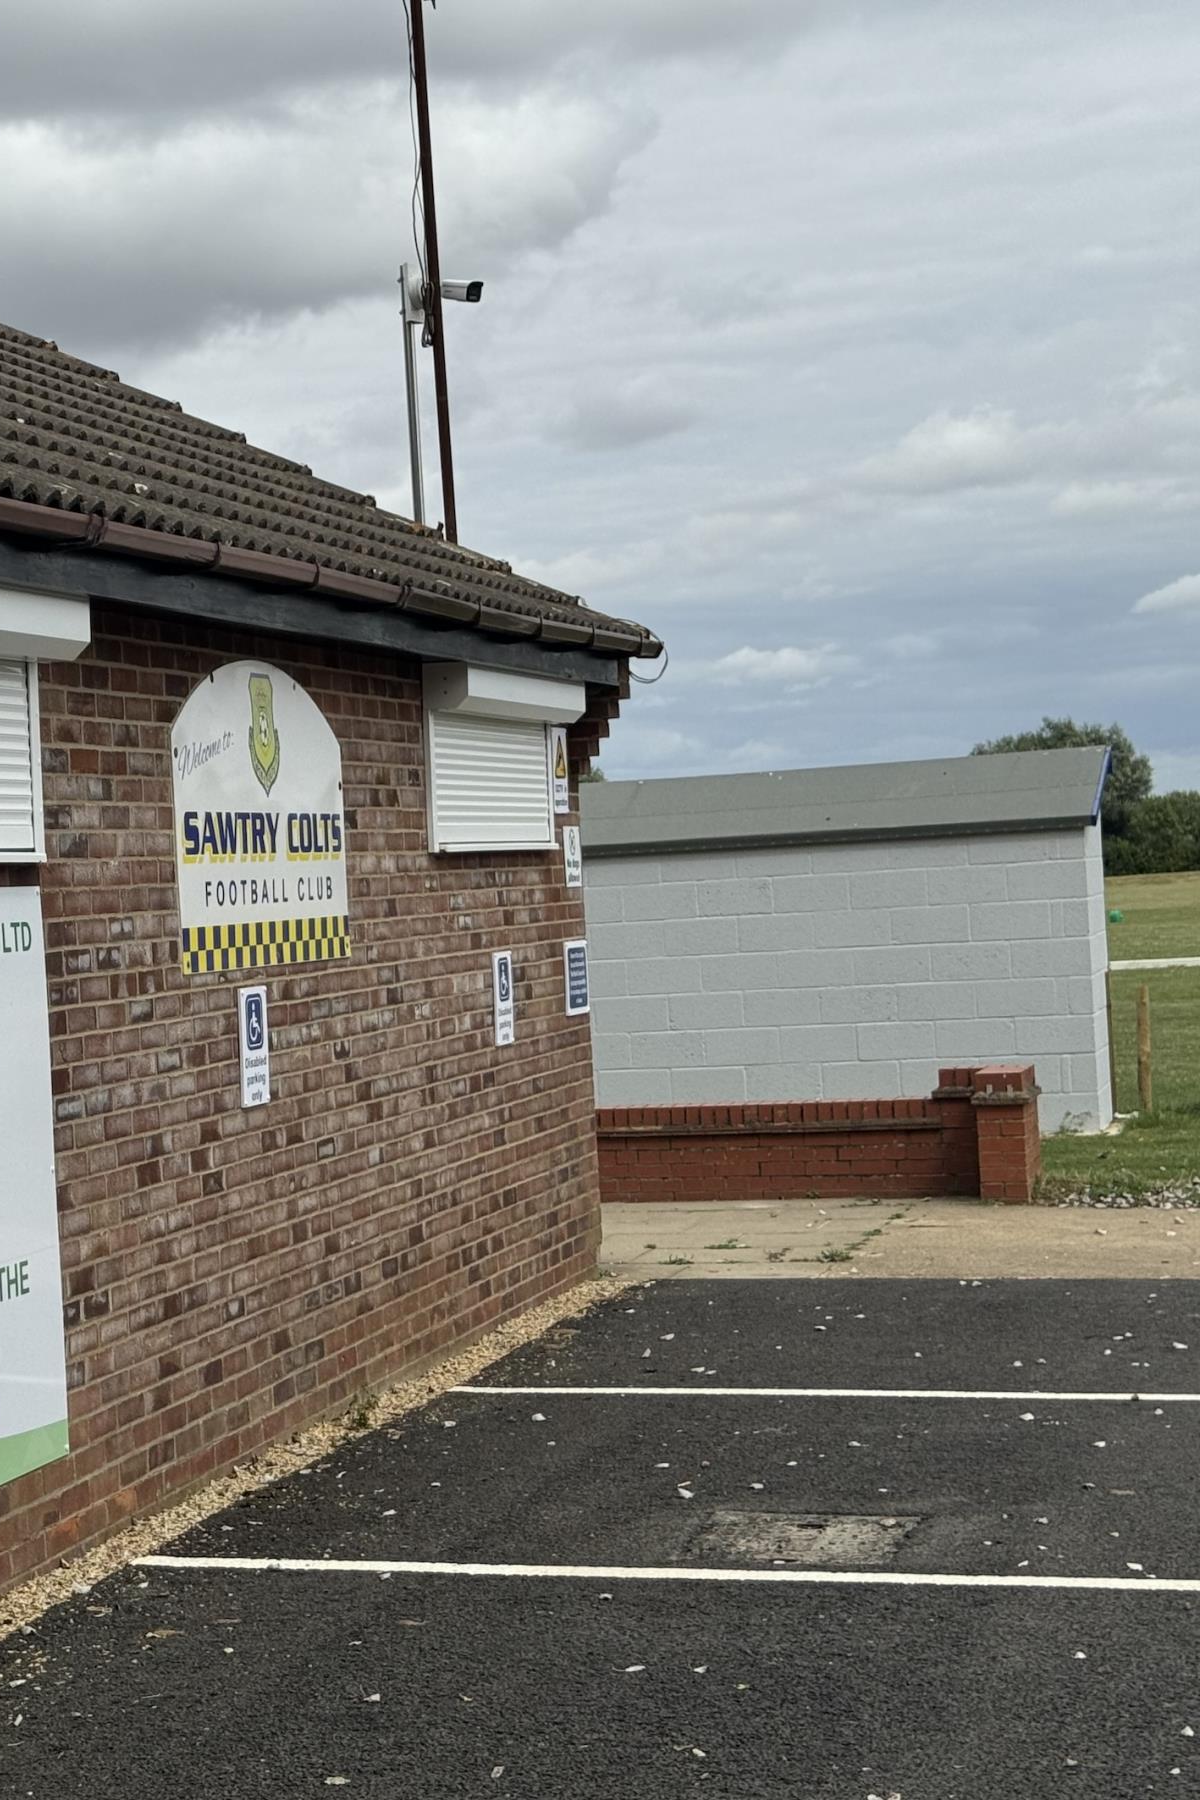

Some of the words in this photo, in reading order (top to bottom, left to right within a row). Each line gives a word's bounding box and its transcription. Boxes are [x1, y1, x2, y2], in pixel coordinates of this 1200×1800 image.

[178, 739, 221, 781] Welcome
[183, 811, 280, 859] SAWTRY
[287, 812, 342, 857] COLTS
[205, 878, 288, 907] FOOTBALL
[297, 876, 333, 902] CLUB
[1, 921, 32, 953] LTD
[245, 1055, 267, 1069] Disabled
[246, 1072, 266, 1088] parking
